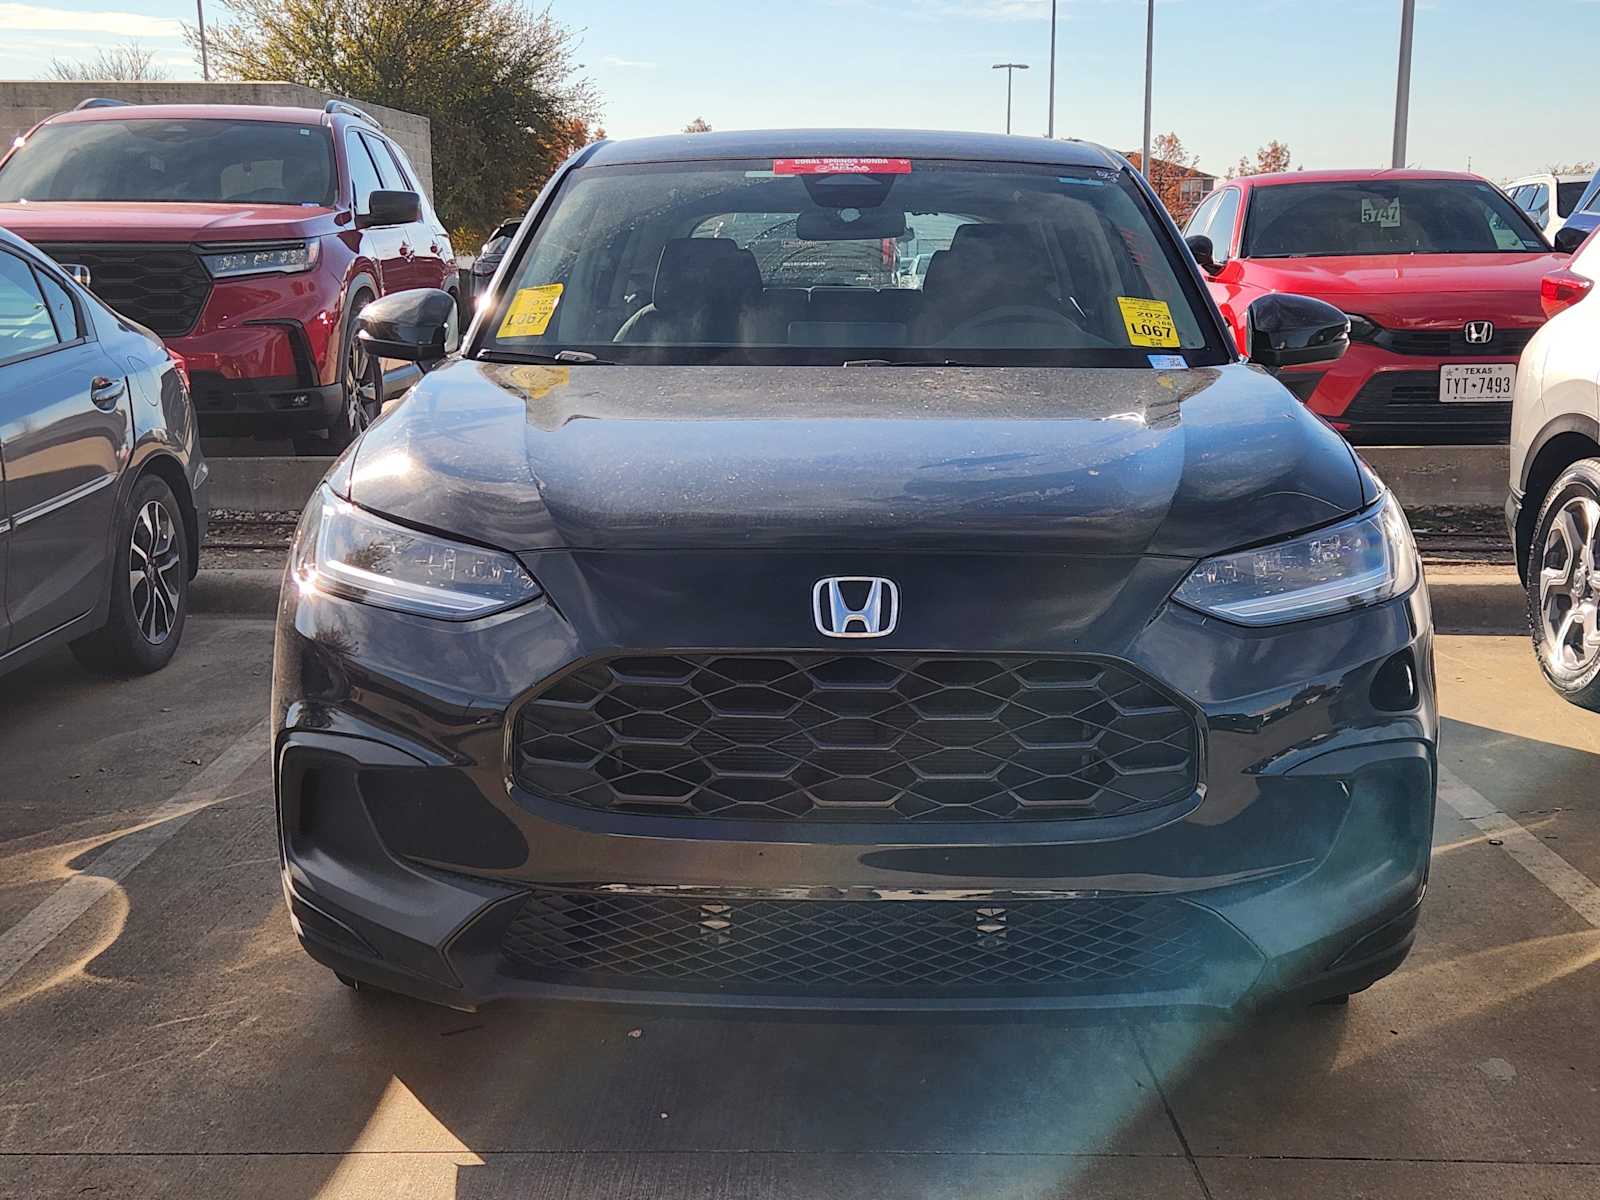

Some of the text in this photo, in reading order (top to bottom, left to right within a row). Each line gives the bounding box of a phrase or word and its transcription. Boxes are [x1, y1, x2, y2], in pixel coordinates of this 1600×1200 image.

[1363, 206, 1398, 221] 5747
[1131, 322, 1171, 338] L067
[1465, 367, 1493, 375] TEXAS
